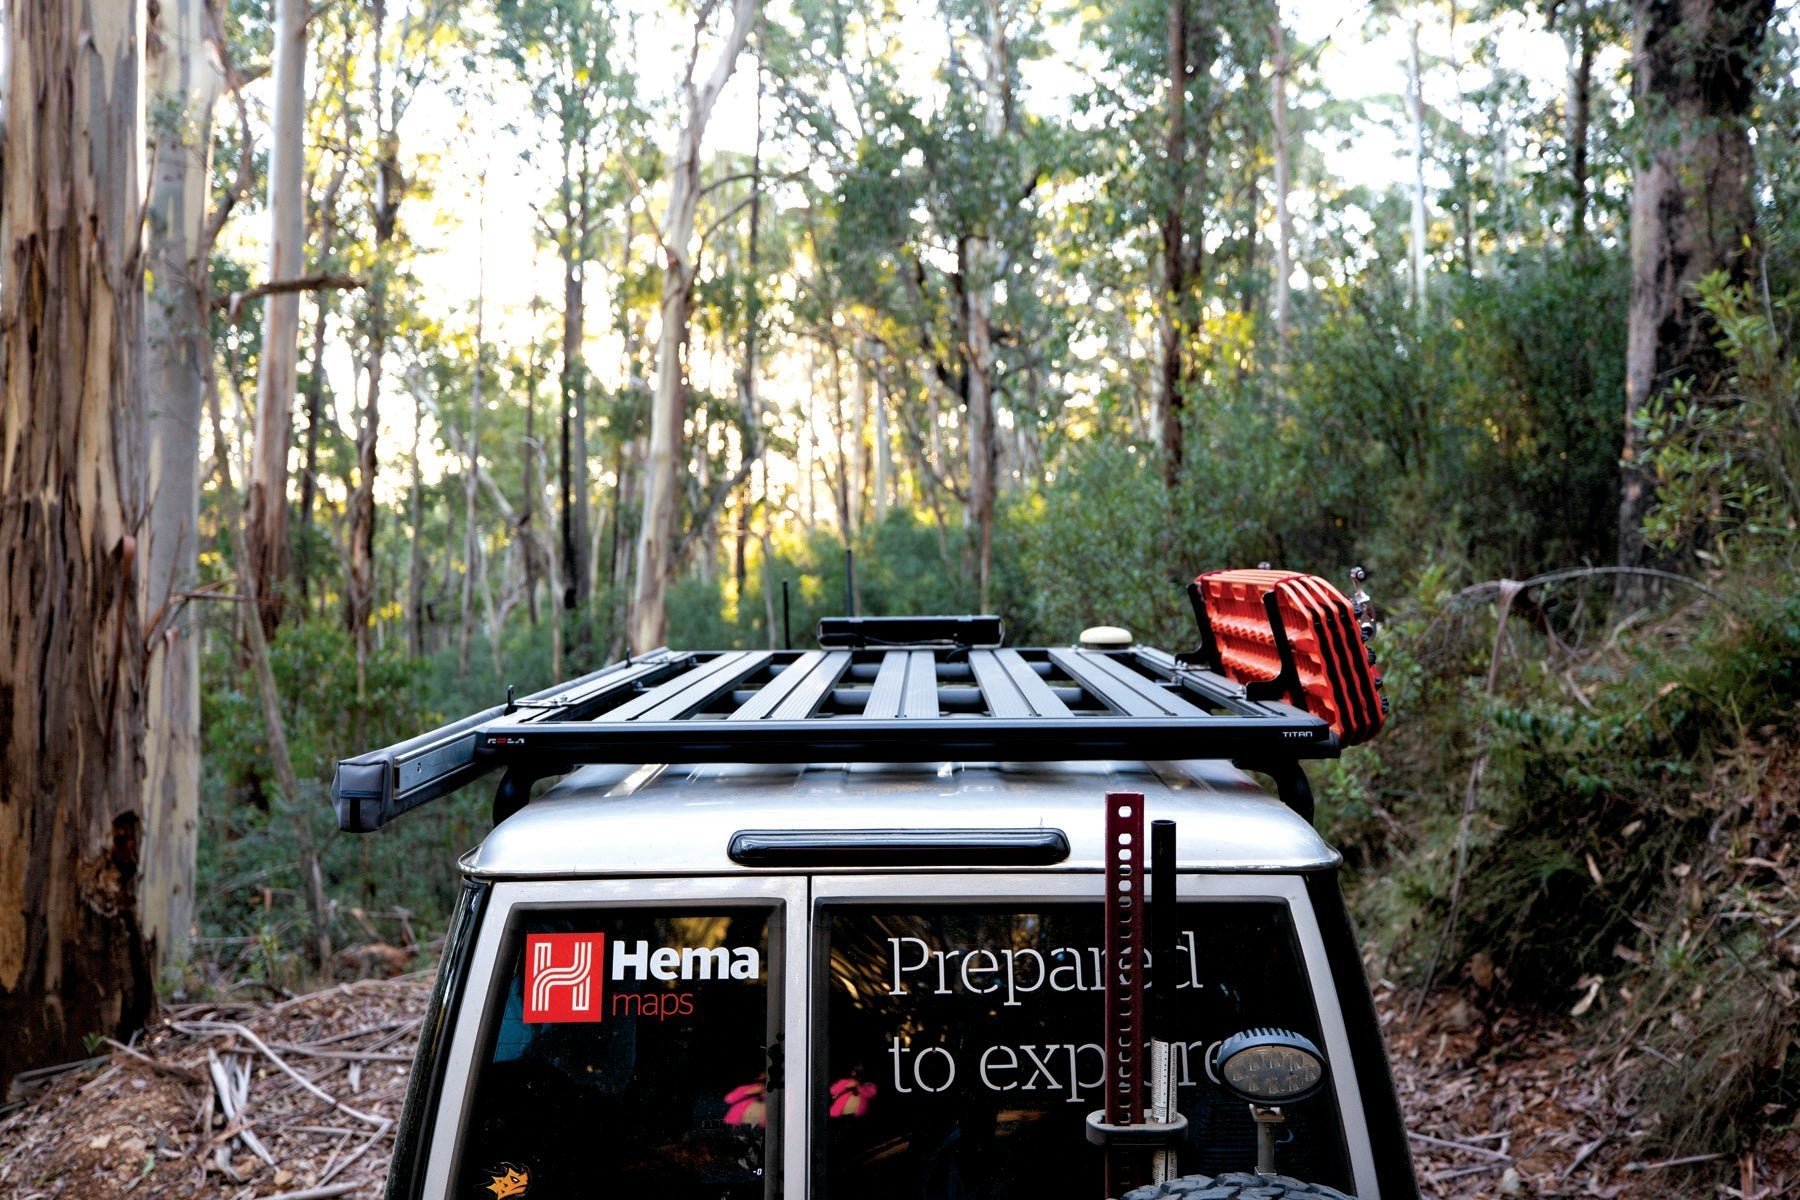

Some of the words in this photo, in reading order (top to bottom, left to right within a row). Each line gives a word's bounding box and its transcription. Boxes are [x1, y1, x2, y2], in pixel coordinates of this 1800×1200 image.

[611, 940, 760, 981] Hema
[612, 992, 694, 1021] maps
[888, 1036, 956, 1093] to
